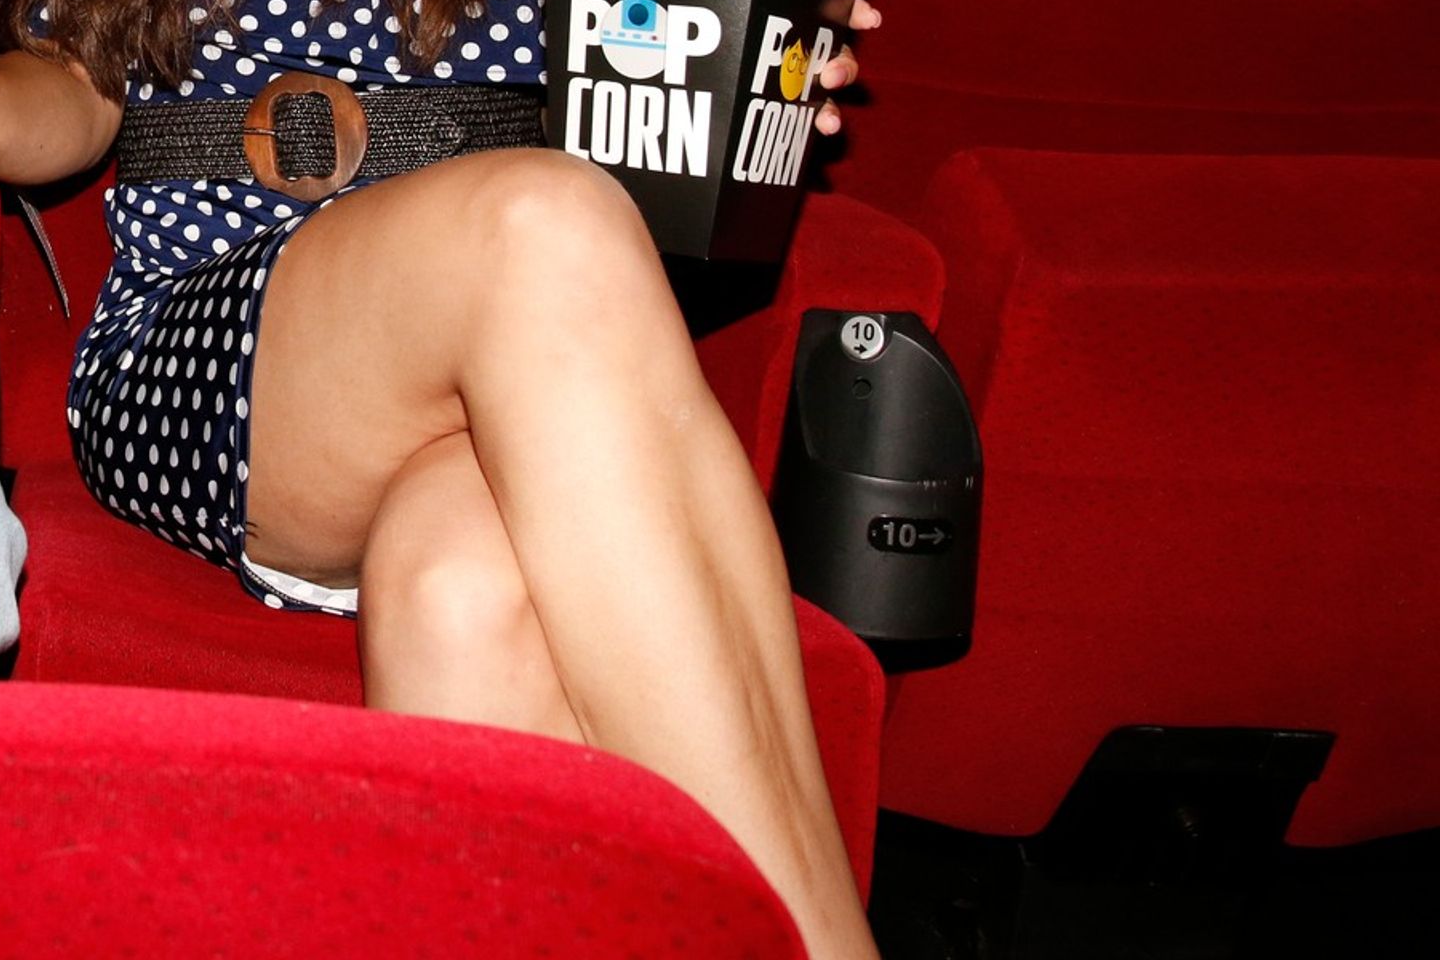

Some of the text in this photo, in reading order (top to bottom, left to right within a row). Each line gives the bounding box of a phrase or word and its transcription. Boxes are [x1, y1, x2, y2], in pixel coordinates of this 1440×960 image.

[750, 14, 834, 102] POP
[565, 77, 712, 177] CORN
[732, 98, 815, 187] CORN
[851, 322, 875, 341] 10
[882, 521, 917, 548] 10
